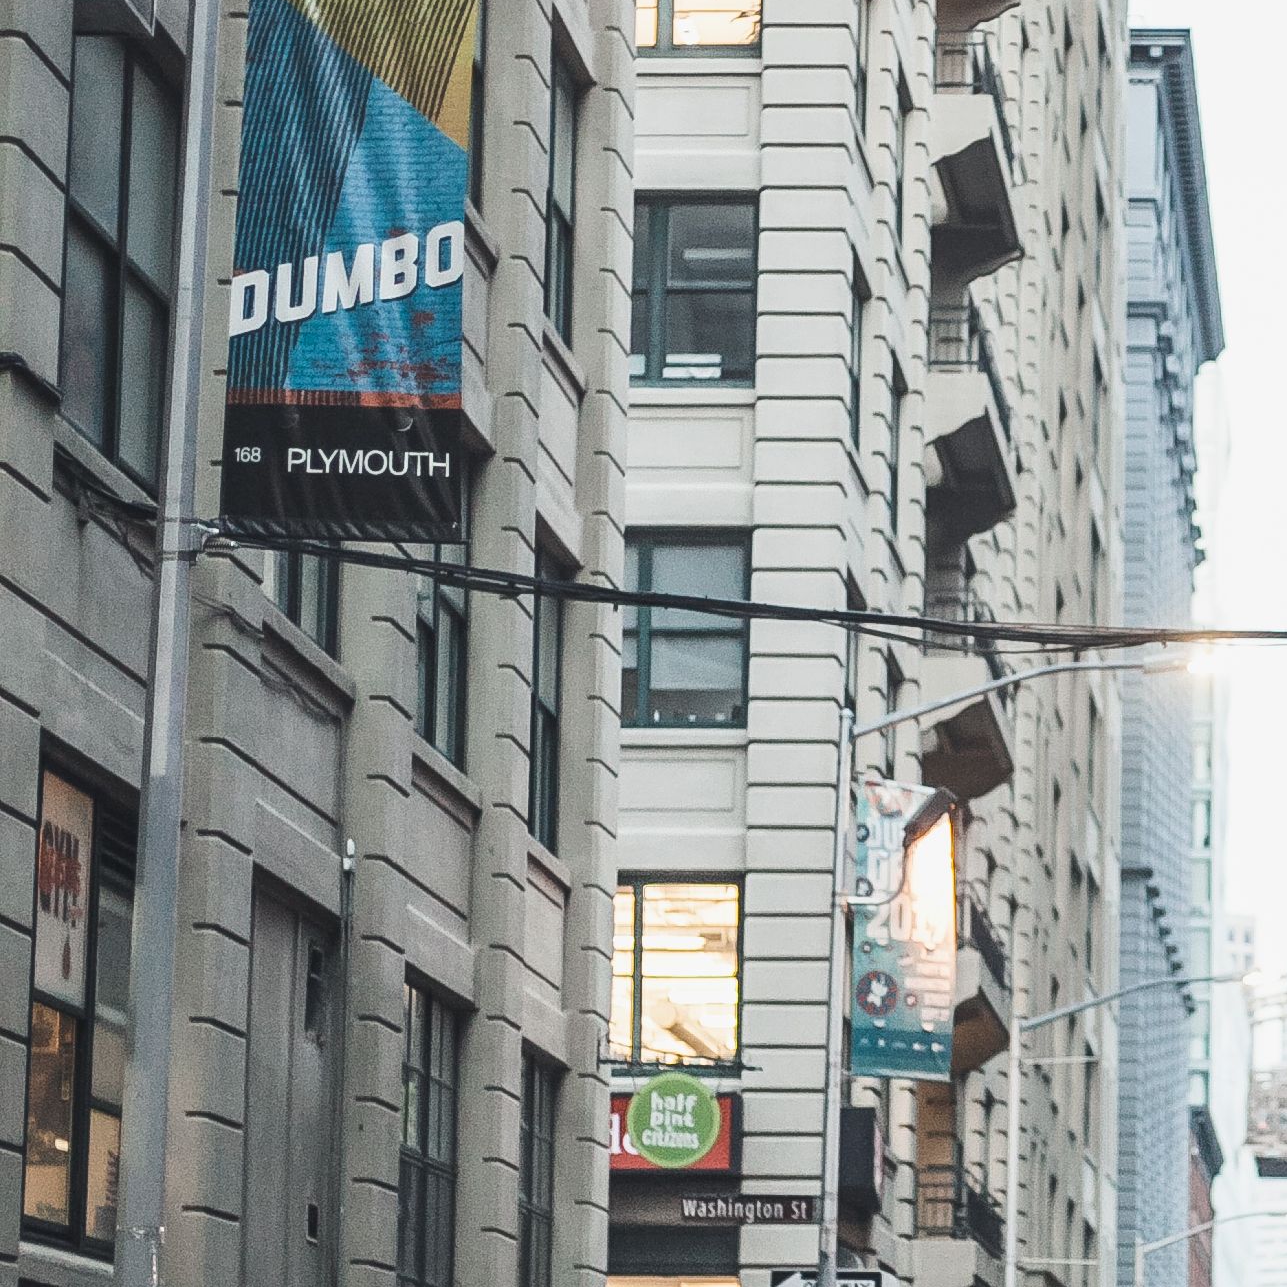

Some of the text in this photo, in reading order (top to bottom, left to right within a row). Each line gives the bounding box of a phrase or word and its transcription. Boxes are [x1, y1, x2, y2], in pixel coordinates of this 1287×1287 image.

[229, 220, 465, 338] DUMBO
[234, 446, 451, 477] 168 PLYMOUTH
[650, 1090, 698, 1113] half
[650, 1111, 695, 1130] pint
[682, 1198, 807, 1224] Washington St
